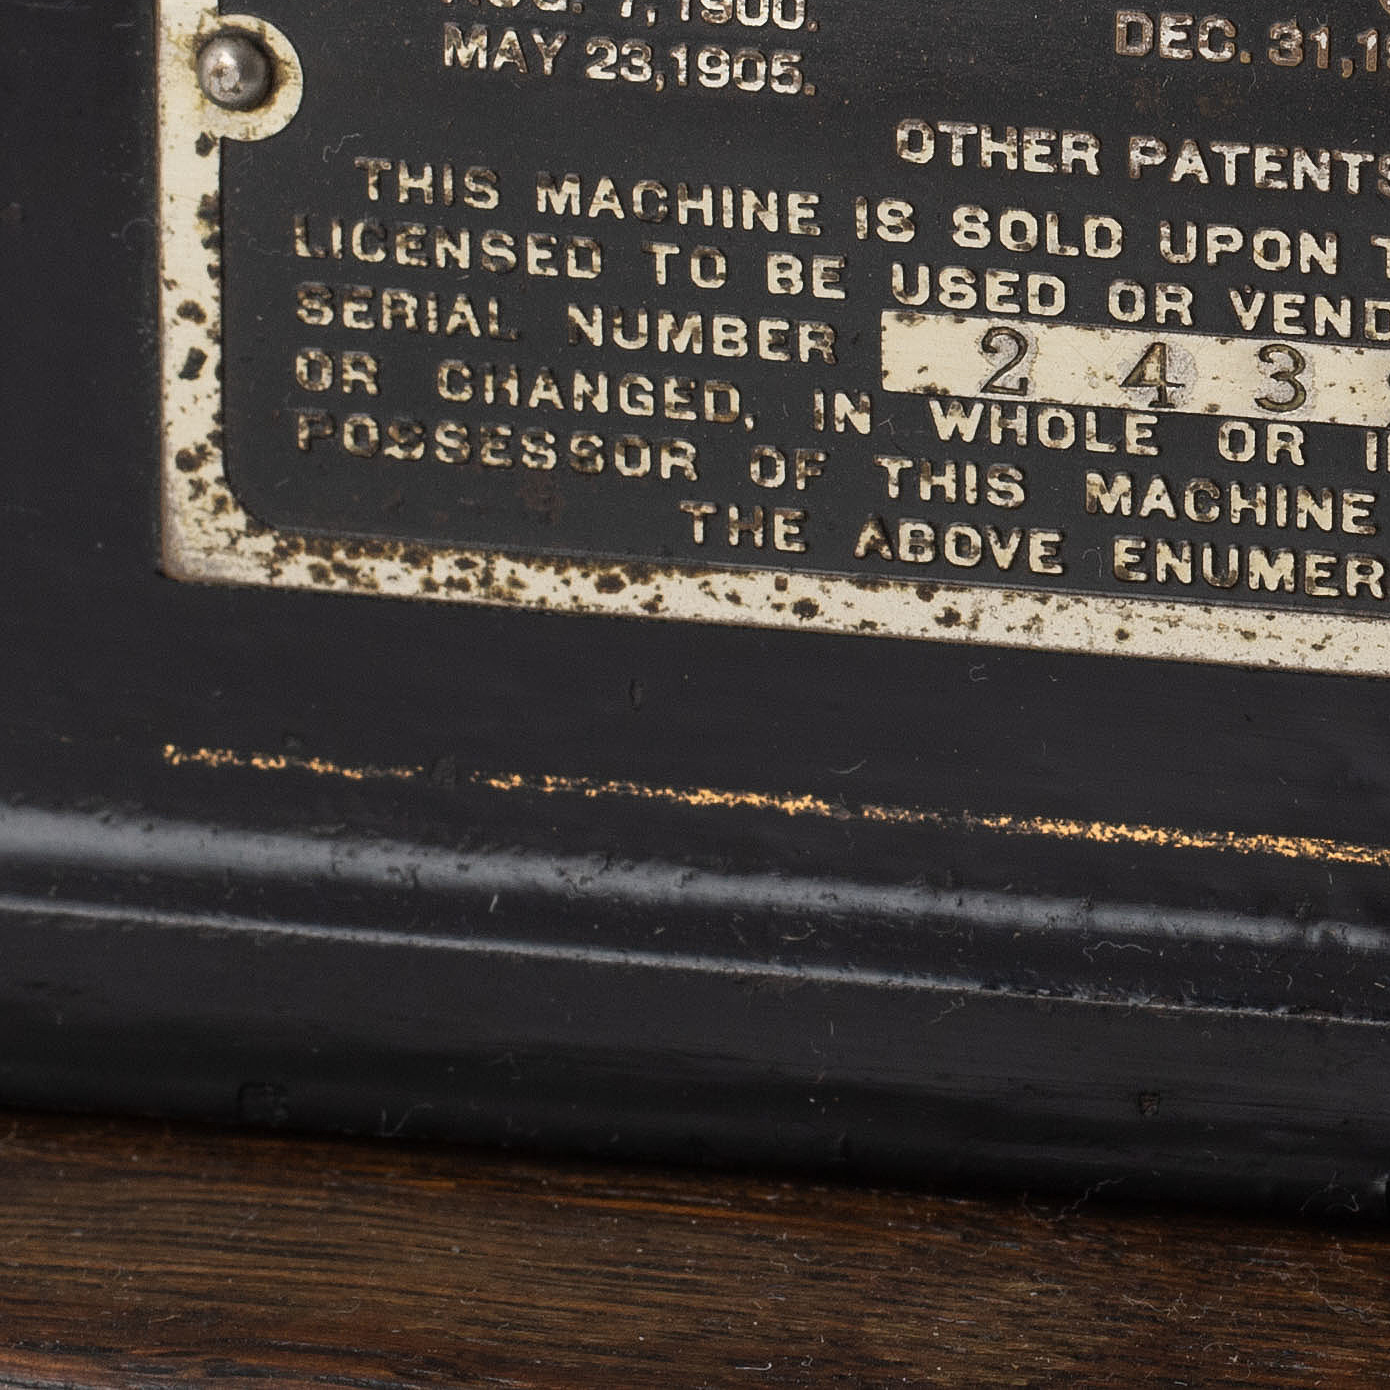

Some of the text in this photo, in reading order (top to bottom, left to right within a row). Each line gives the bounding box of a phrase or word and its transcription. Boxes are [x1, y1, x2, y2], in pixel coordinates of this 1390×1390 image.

[442, 21, 816, 96] MAY 23,1905.
[1114, 9, 1251, 64] DEC.
[895, 118, 1100, 176] OTHER
[353, 155, 500, 210] THIS
[535, 173, 822, 237] MACHINE
[854, 195, 916, 243] IS
[951, 204, 1123, 259] SOLD
[1159, 220, 1338, 276] UPON
[293, 215, 602, 280] LICENSED
[649, 241, 727, 290] TO
[765, 251, 846, 300] BE
[891, 261, 1066, 317] USED
[1107, 278, 1194, 327] OR
[295, 281, 516, 340] SERIAL
[567, 303, 835, 364] NUMBER
[294, 347, 378, 395] OR
[813, 389, 871, 435] IN
[928, 397, 1159, 457] WHOLE
[1217, 419, 1305, 467] OR
[296, 412, 698, 482] POSSESSOR
[749, 444, 826, 491] OF
[874, 454, 1026, 508] THIS
[1085, 470, 1376, 535] MACHINE
[679, 500, 806, 553] THE
[854, 517, 1063, 581] ABOVE
